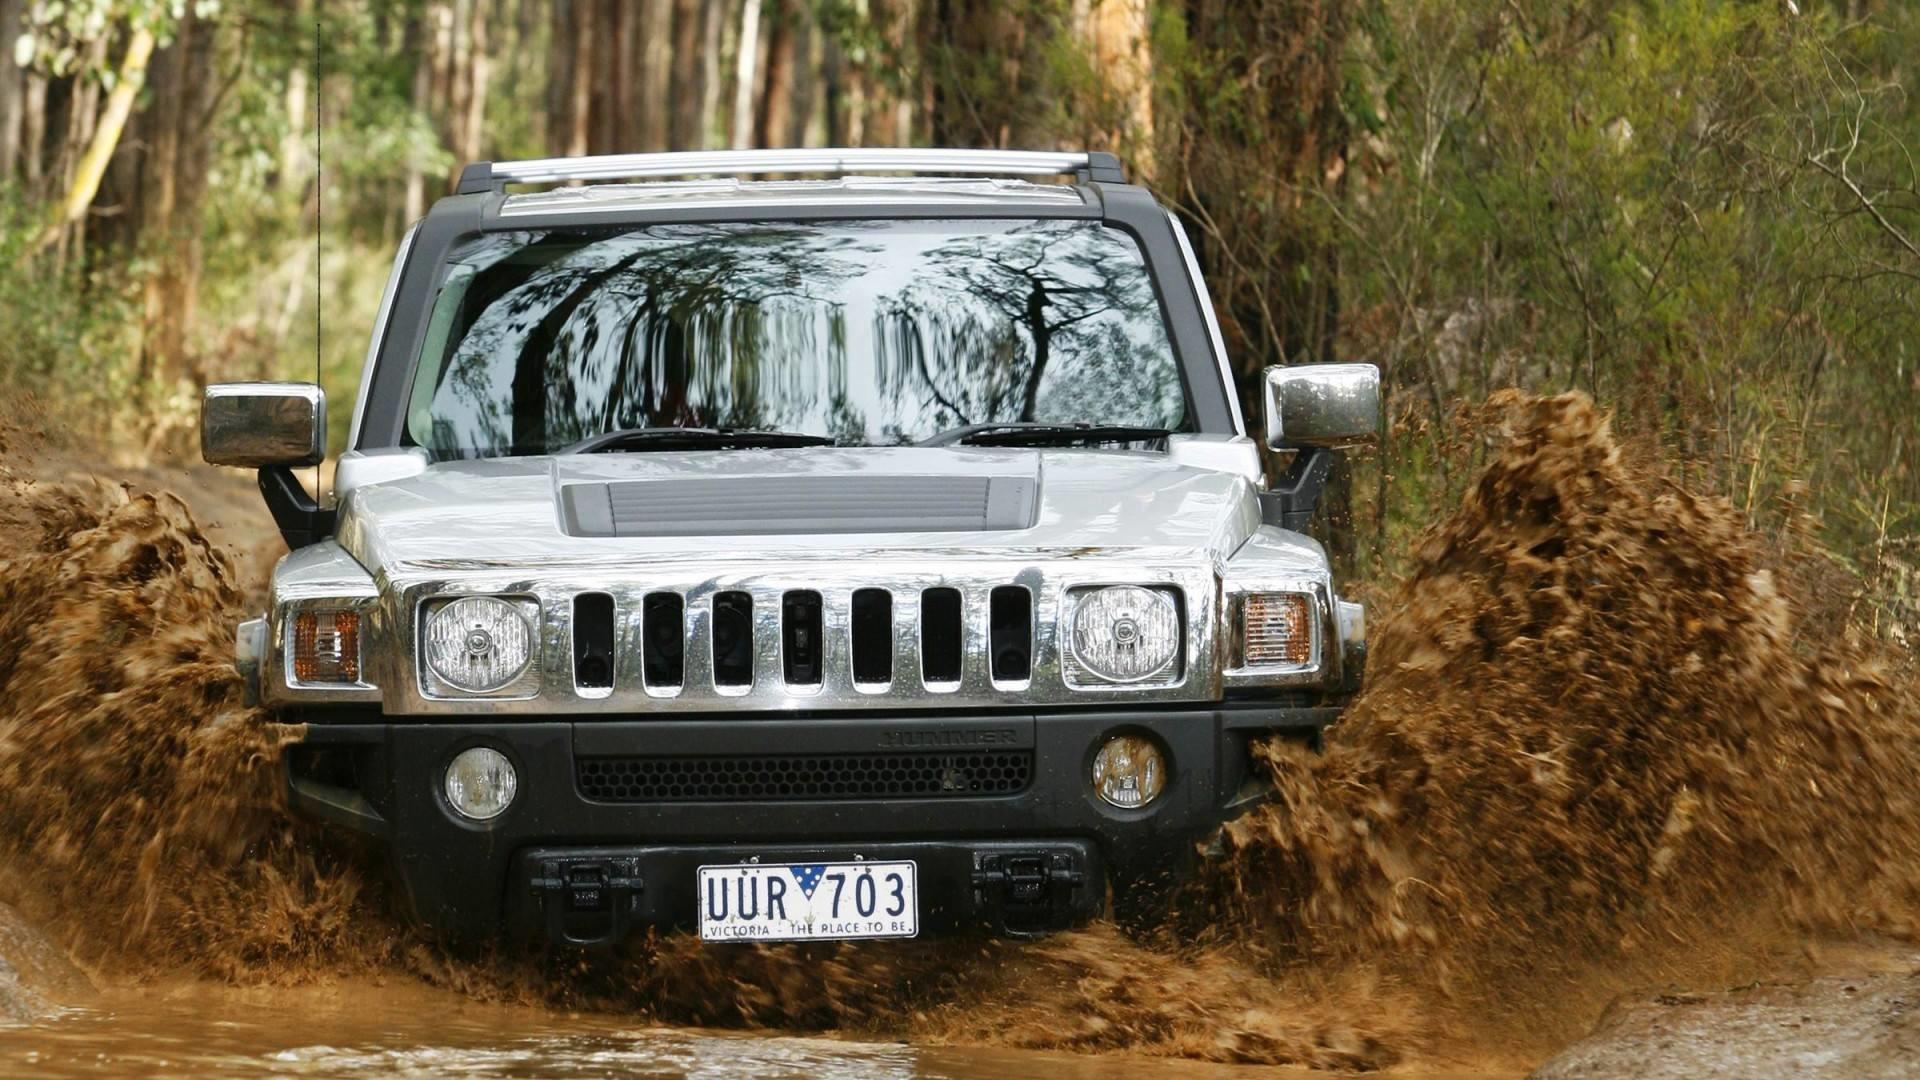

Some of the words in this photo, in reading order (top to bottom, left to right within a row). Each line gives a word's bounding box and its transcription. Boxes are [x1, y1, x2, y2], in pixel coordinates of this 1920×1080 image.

[881, 730, 1017, 747] HUMMER
[708, 876, 787, 921] UUR
[826, 873, 905, 918] 703
[710, 926, 770, 937] VICTORIA
[791, 923, 813, 935] THE
[821, 922, 859, 933] PLACE
[868, 922, 884, 932] TO
[891, 921, 906, 932] BE
